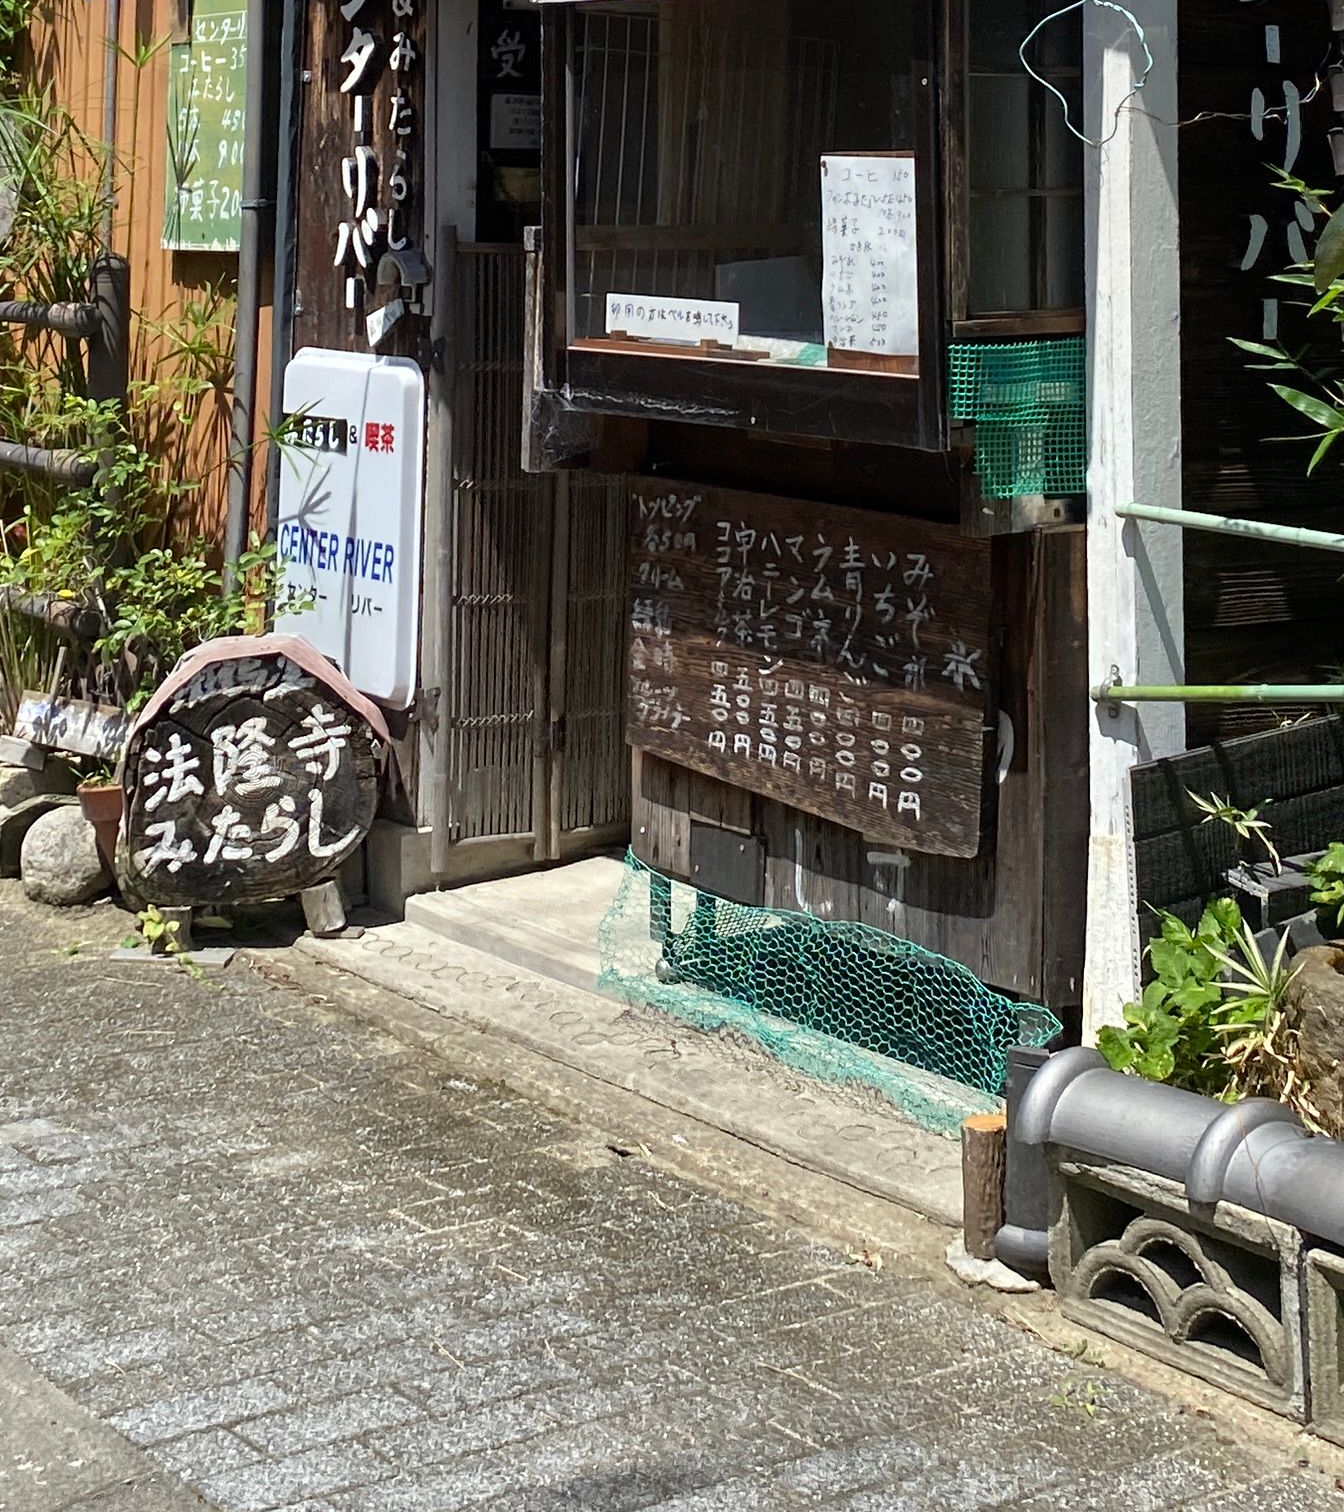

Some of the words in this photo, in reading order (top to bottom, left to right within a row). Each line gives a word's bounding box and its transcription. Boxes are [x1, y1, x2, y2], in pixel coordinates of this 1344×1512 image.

[349, 425, 358, 445] &
[365, 421, 394, 453] 喫茶
[280, 523, 339, 573] CENTER
[343, 536, 394, 585] RIVER
[351, 594, 382, 616] リバー
[941, 639, 983, 693] 氷
[143, 703, 352, 812] 法隆寺
[133, 788, 360, 878] みたらし
